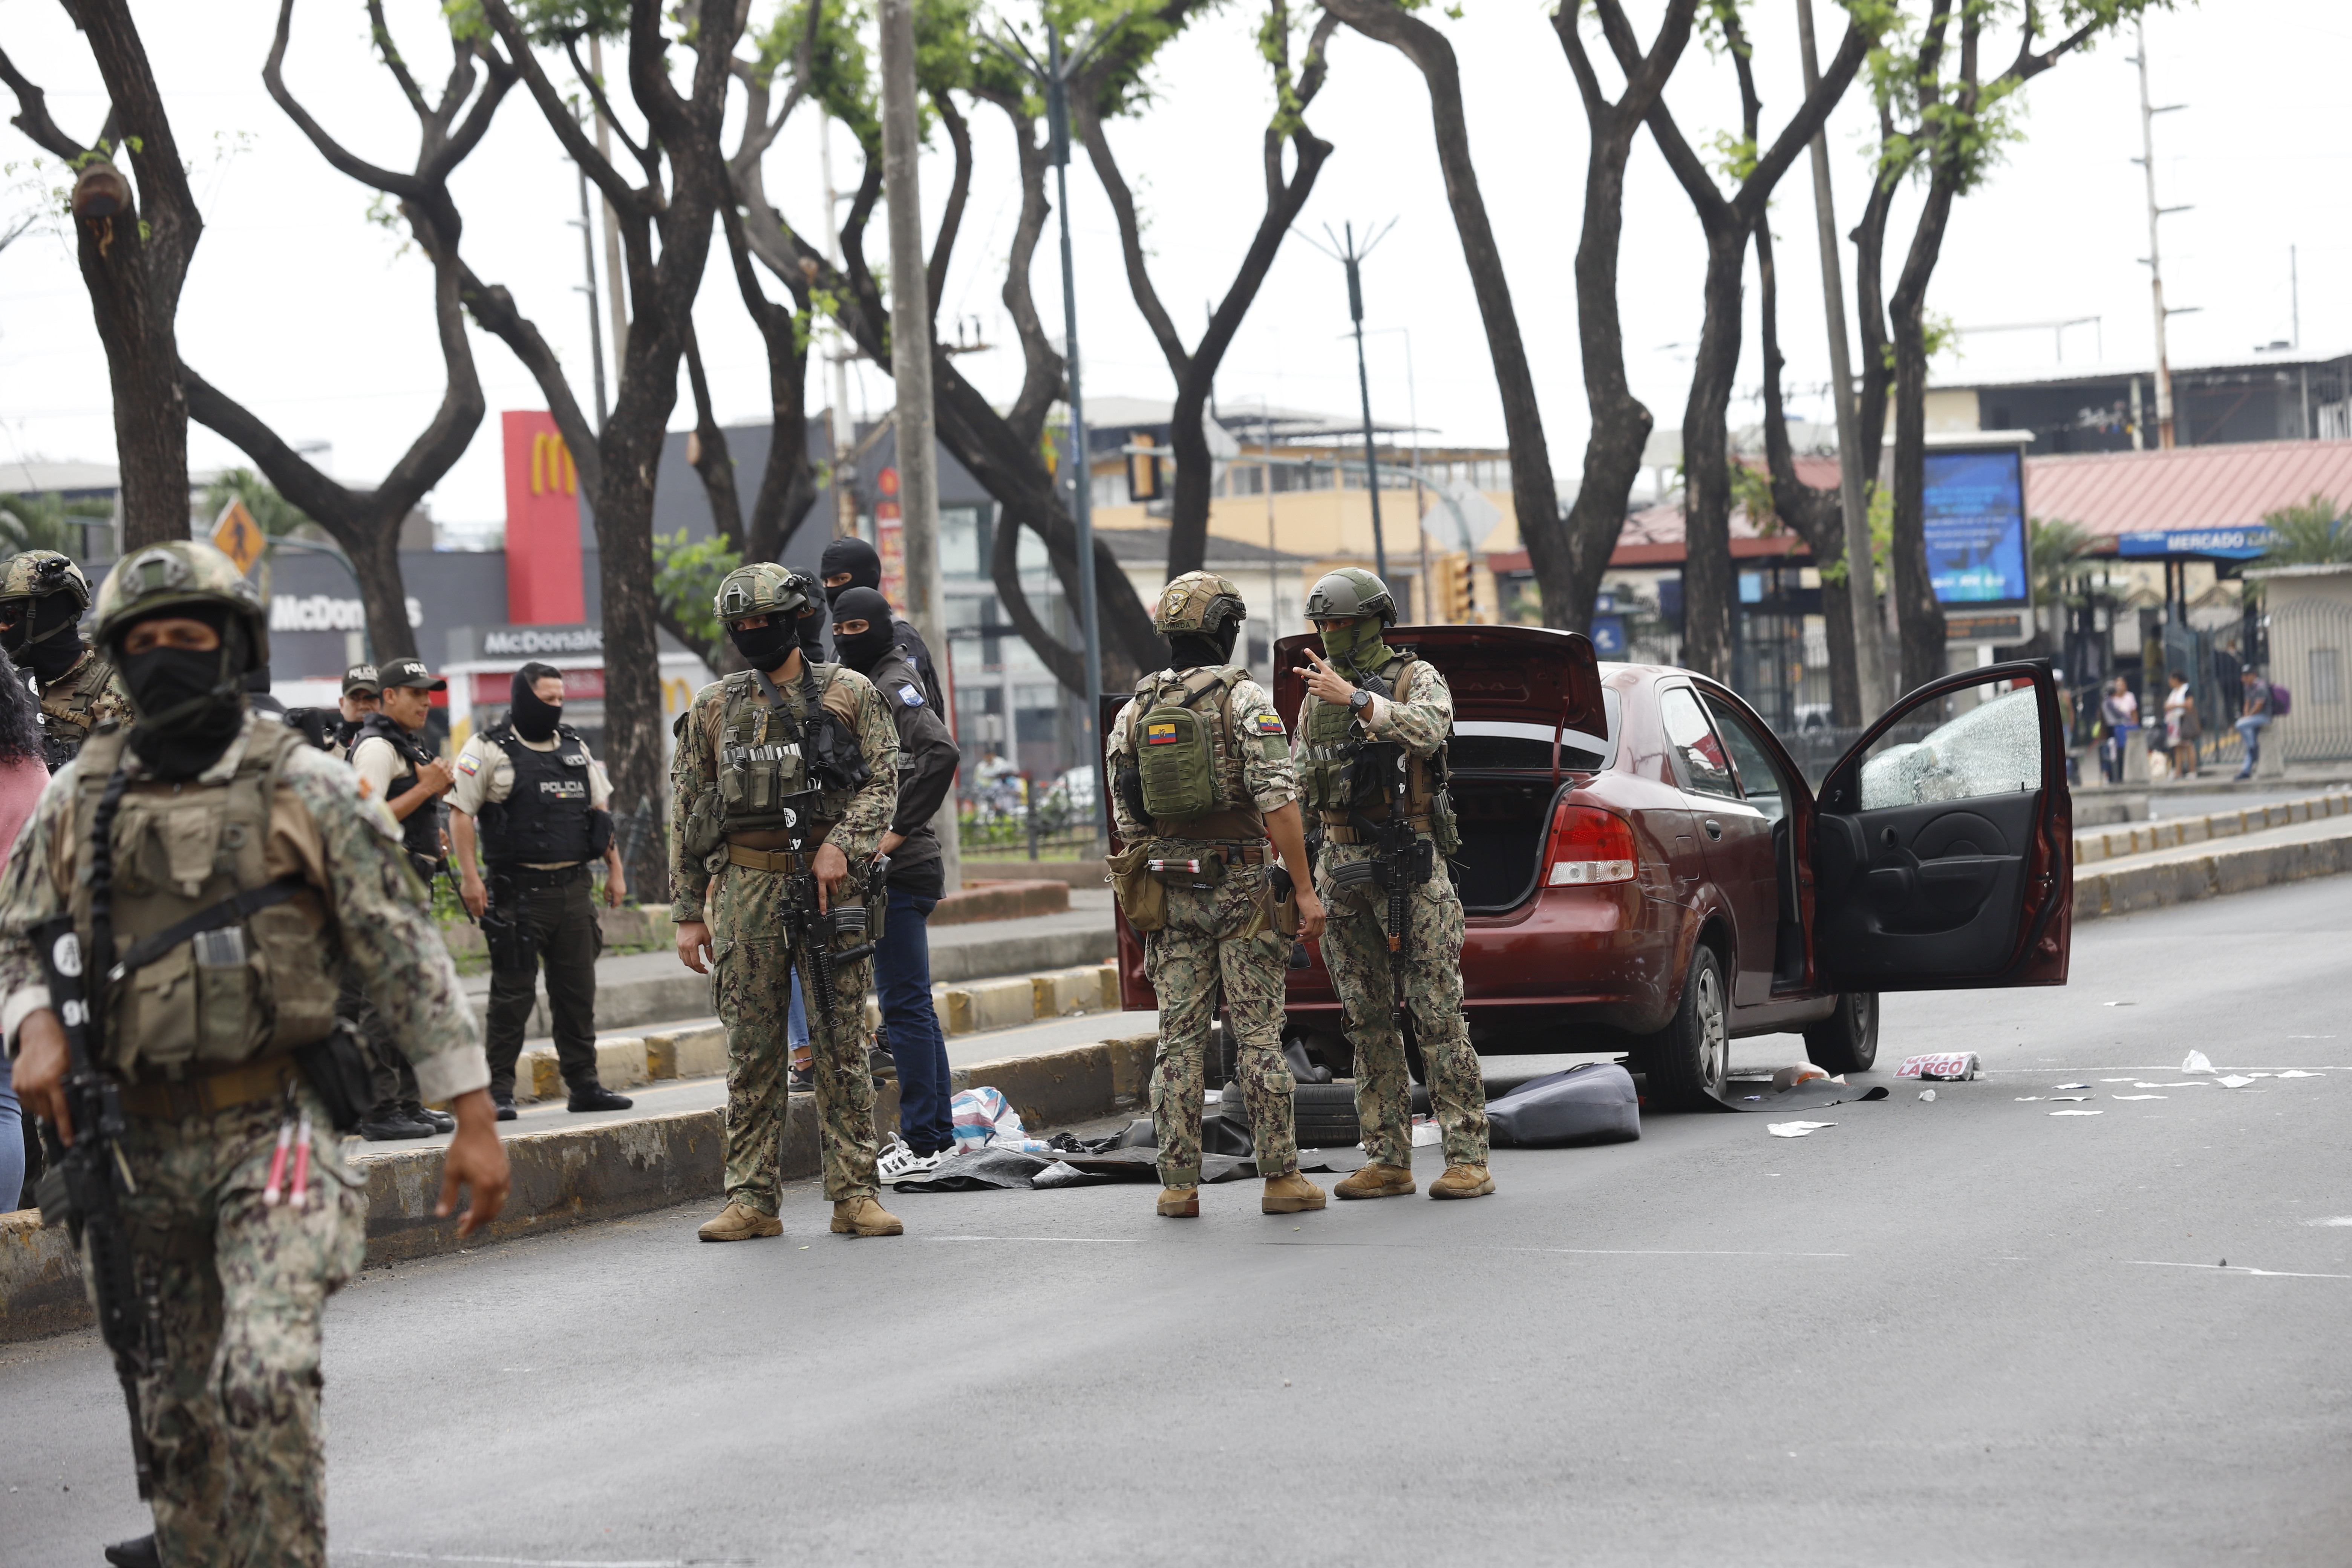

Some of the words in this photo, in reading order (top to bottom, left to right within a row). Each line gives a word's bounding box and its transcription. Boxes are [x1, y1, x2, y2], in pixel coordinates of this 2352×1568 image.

[2167, 531, 2245, 551] MERCADO
[270, 595, 423, 631] McDons
[539, 781, 585, 793] POLICIA
[1895, 1061, 1963, 1076] LARGO
